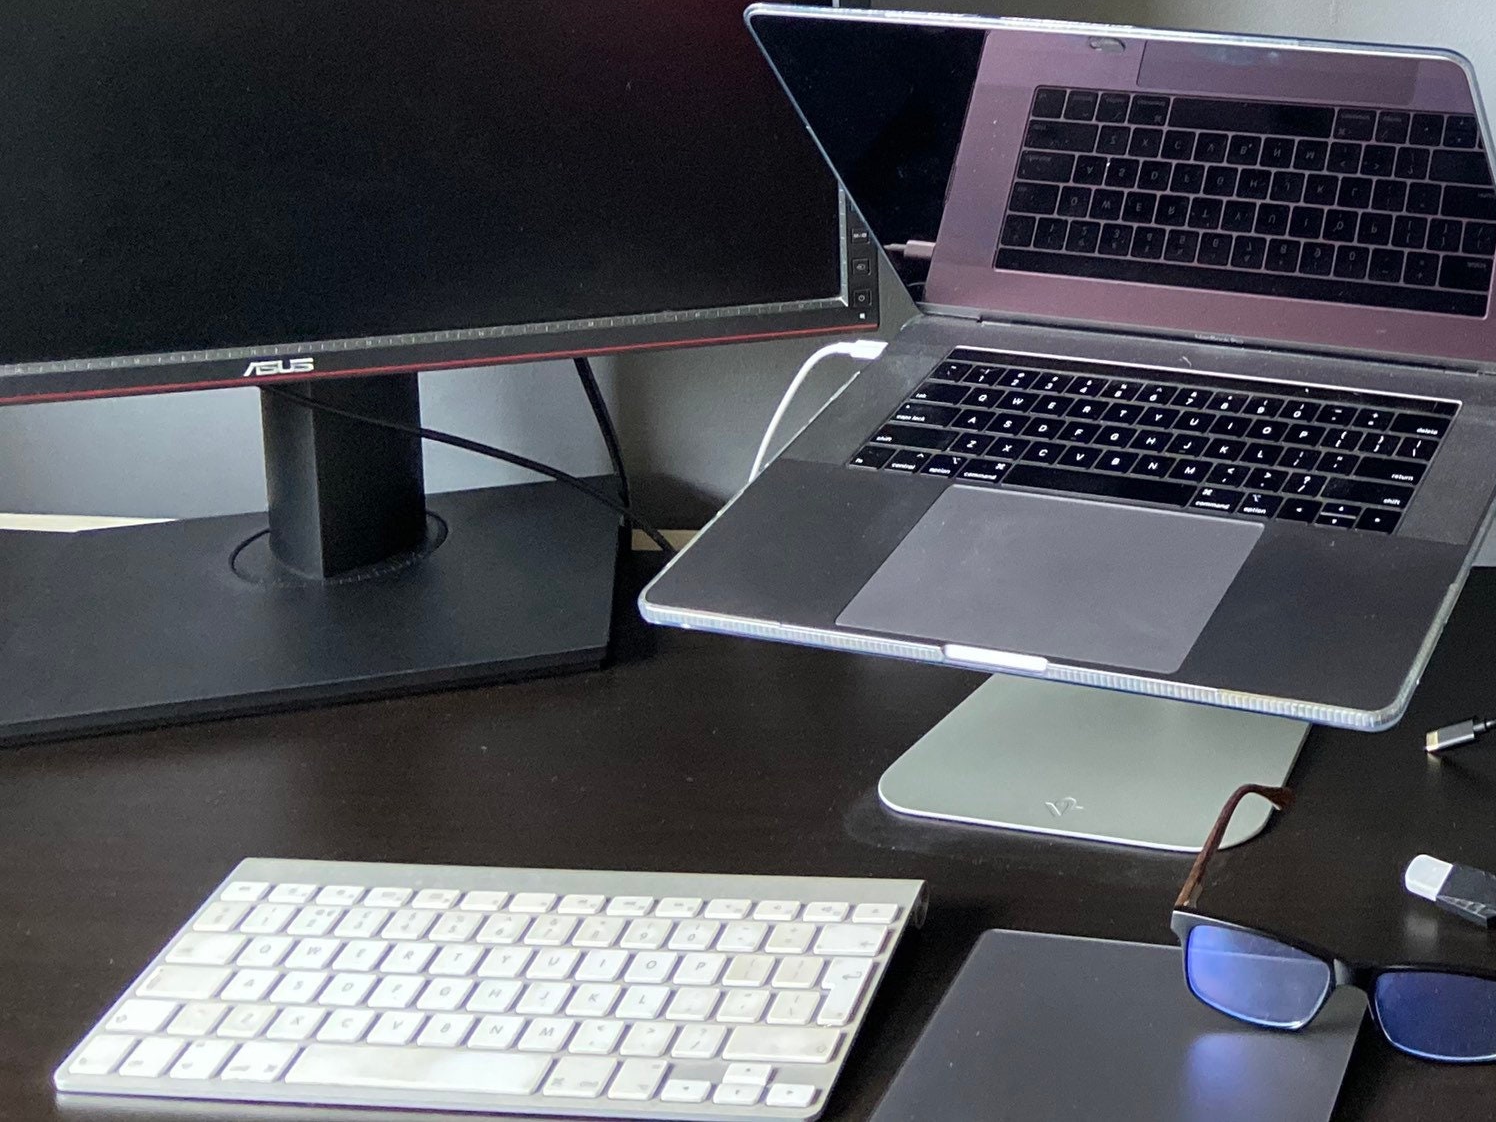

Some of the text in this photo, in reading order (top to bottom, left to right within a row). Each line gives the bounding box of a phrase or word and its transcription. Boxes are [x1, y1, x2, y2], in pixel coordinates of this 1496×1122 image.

[243, 357, 314, 377] ASUS
[891, 462, 916, 470] control
[928, 467, 951, 475] option
[963, 471, 997, 480] command
[1195, 501, 1231, 510] command
[1243, 506, 1267, 515] option
